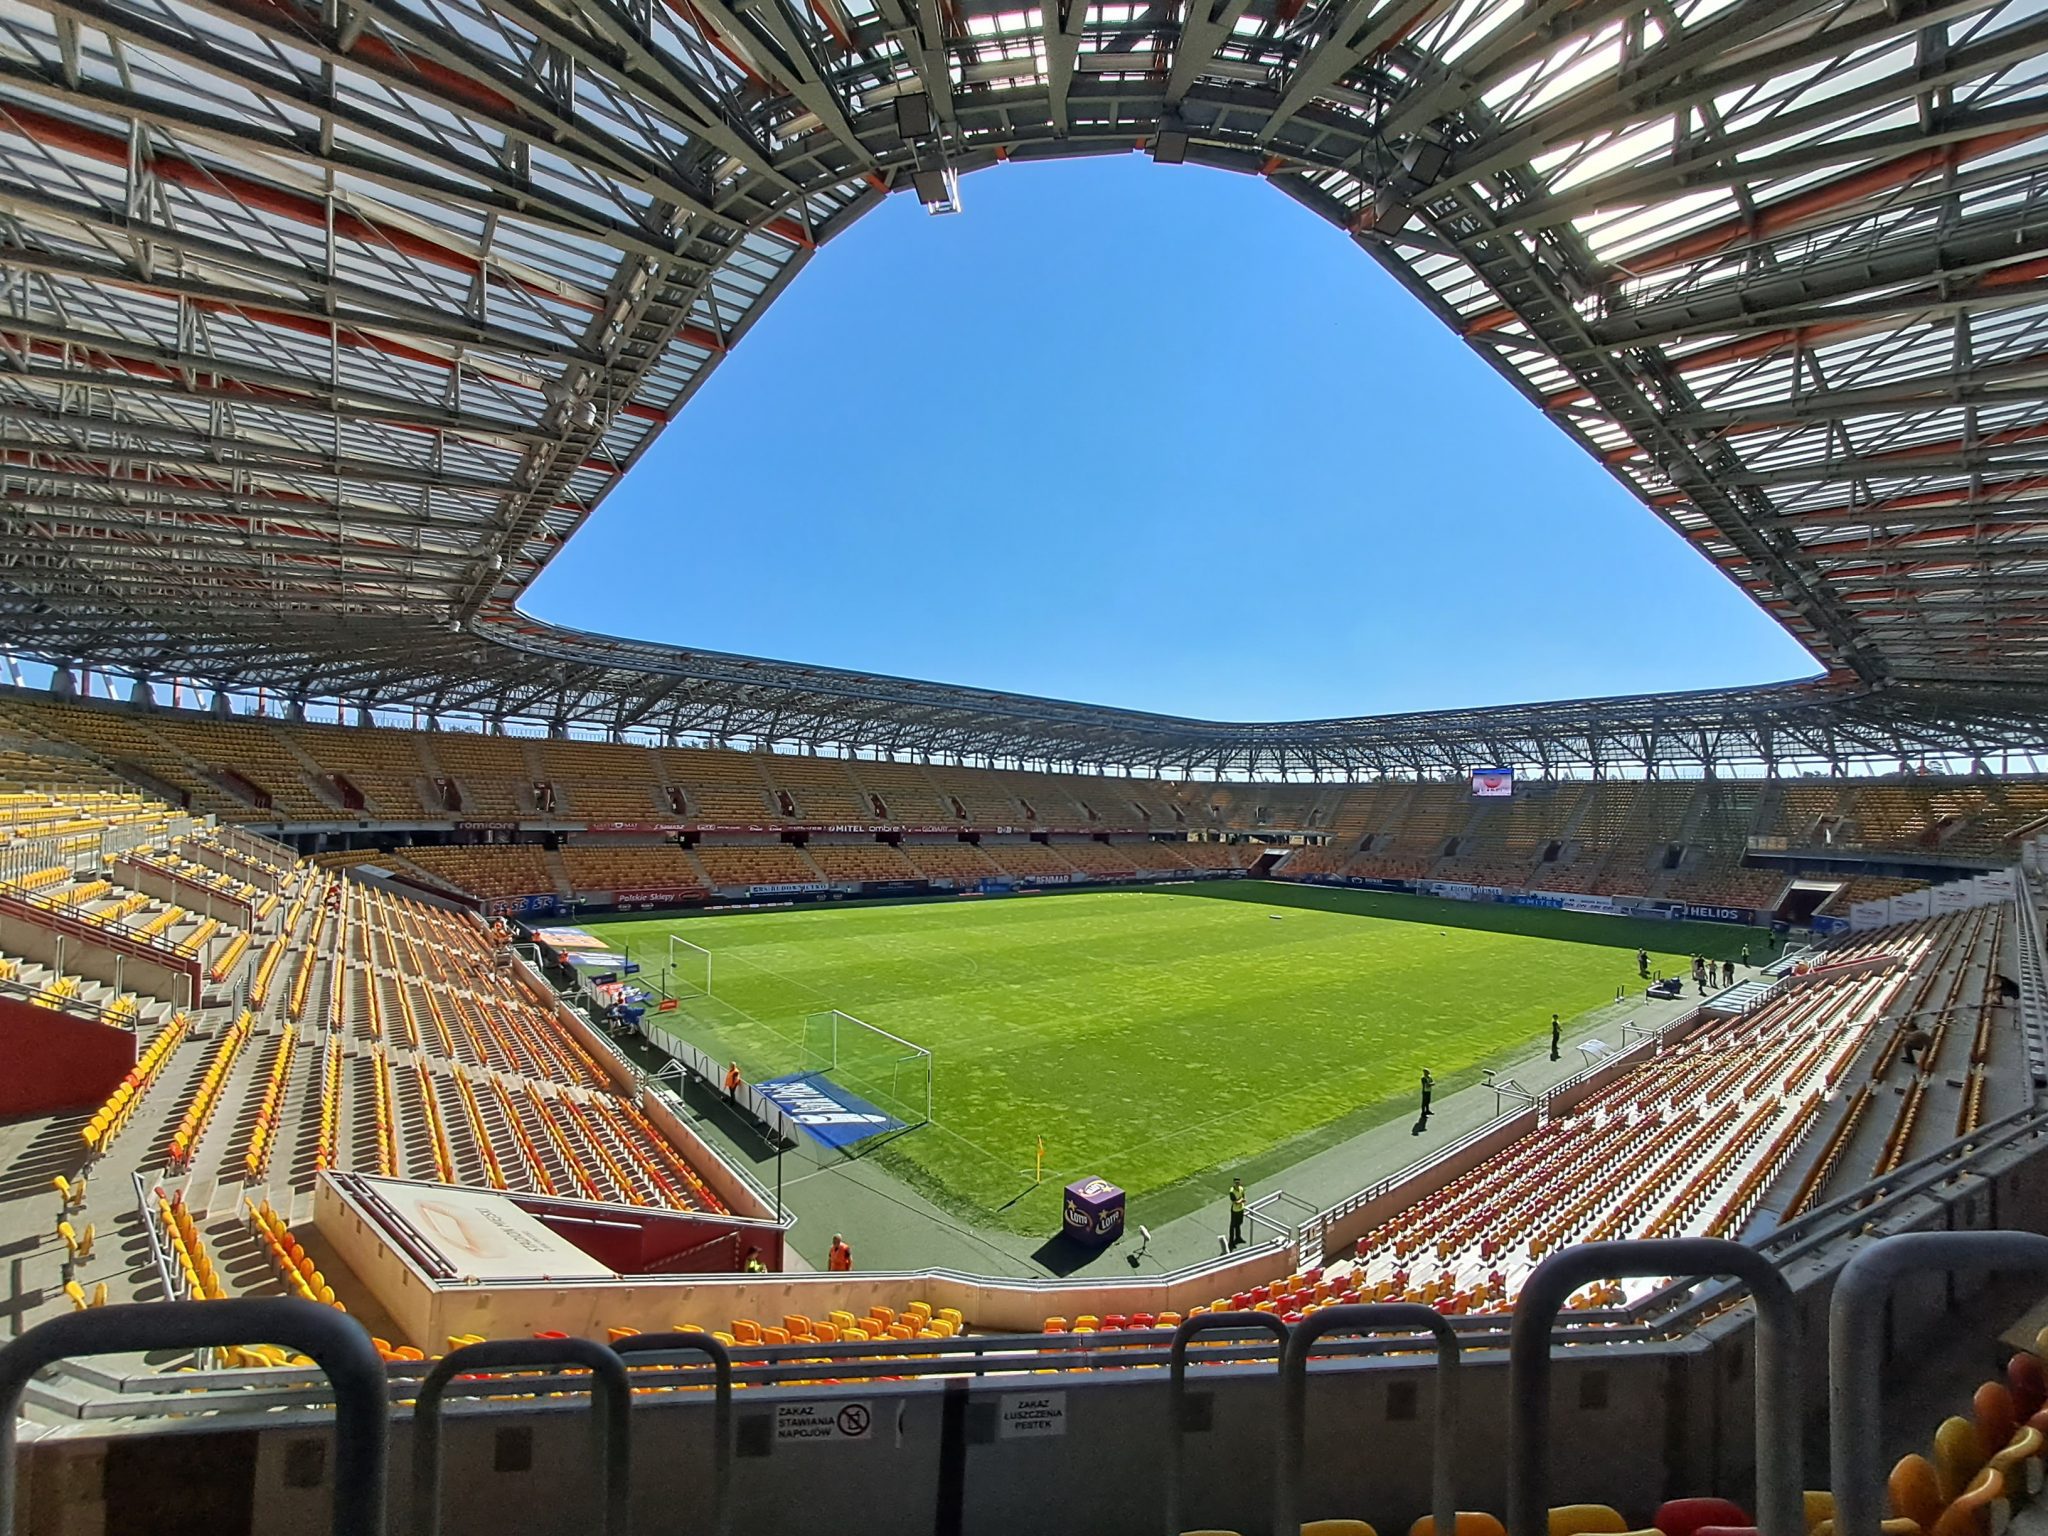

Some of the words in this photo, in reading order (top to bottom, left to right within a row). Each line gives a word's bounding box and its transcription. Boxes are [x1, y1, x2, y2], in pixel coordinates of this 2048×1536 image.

[619, 893, 648, 902] Polskie
[649, 892, 675, 902] Sklepy
[1690, 906, 1738, 919] HELIOS
[1070, 1210, 1088, 1225] LOTTO
[1101, 1210, 1119, 1229] LOTTO
[1018, 1399, 1049, 1408] ZAKAZ
[779, 1406, 814, 1416] ZAKAZ
[779, 1417, 835, 1427] STAWIANIA
[1015, 1420, 1051, 1429] PESTEK
